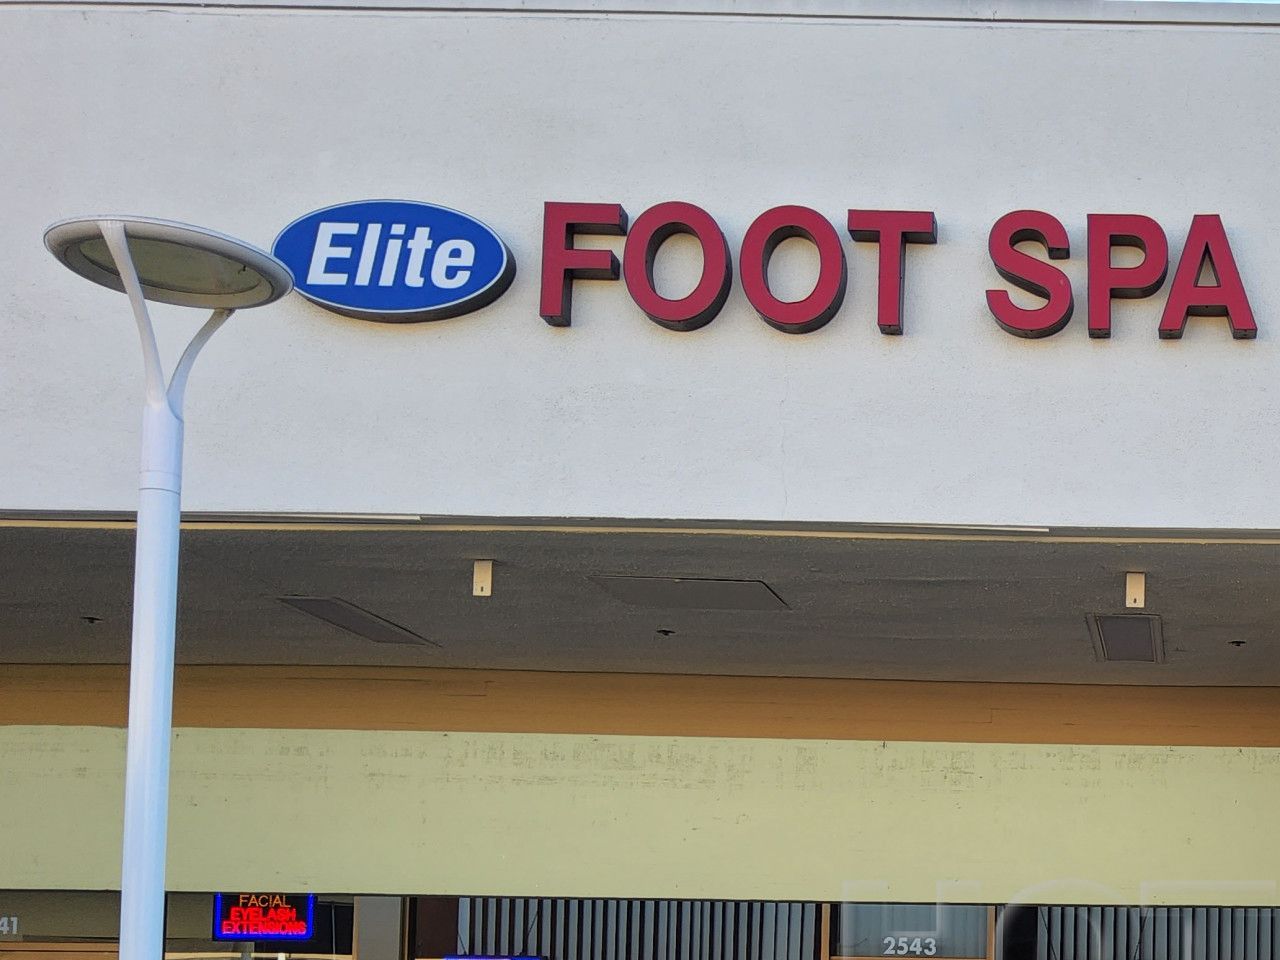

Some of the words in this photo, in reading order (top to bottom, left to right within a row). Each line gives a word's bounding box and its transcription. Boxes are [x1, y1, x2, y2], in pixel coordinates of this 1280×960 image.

[306, 221, 476, 290] Elite
[539, 201, 938, 333] FOOT
[985, 209, 1257, 338] SPA
[239, 894, 291, 908] FACIAL
[230, 907, 297, 921] EYELASH
[0, 916, 18, 934] 41
[222, 920, 307, 935] EXTENSIONS
[882, 936, 937, 956] 2543
